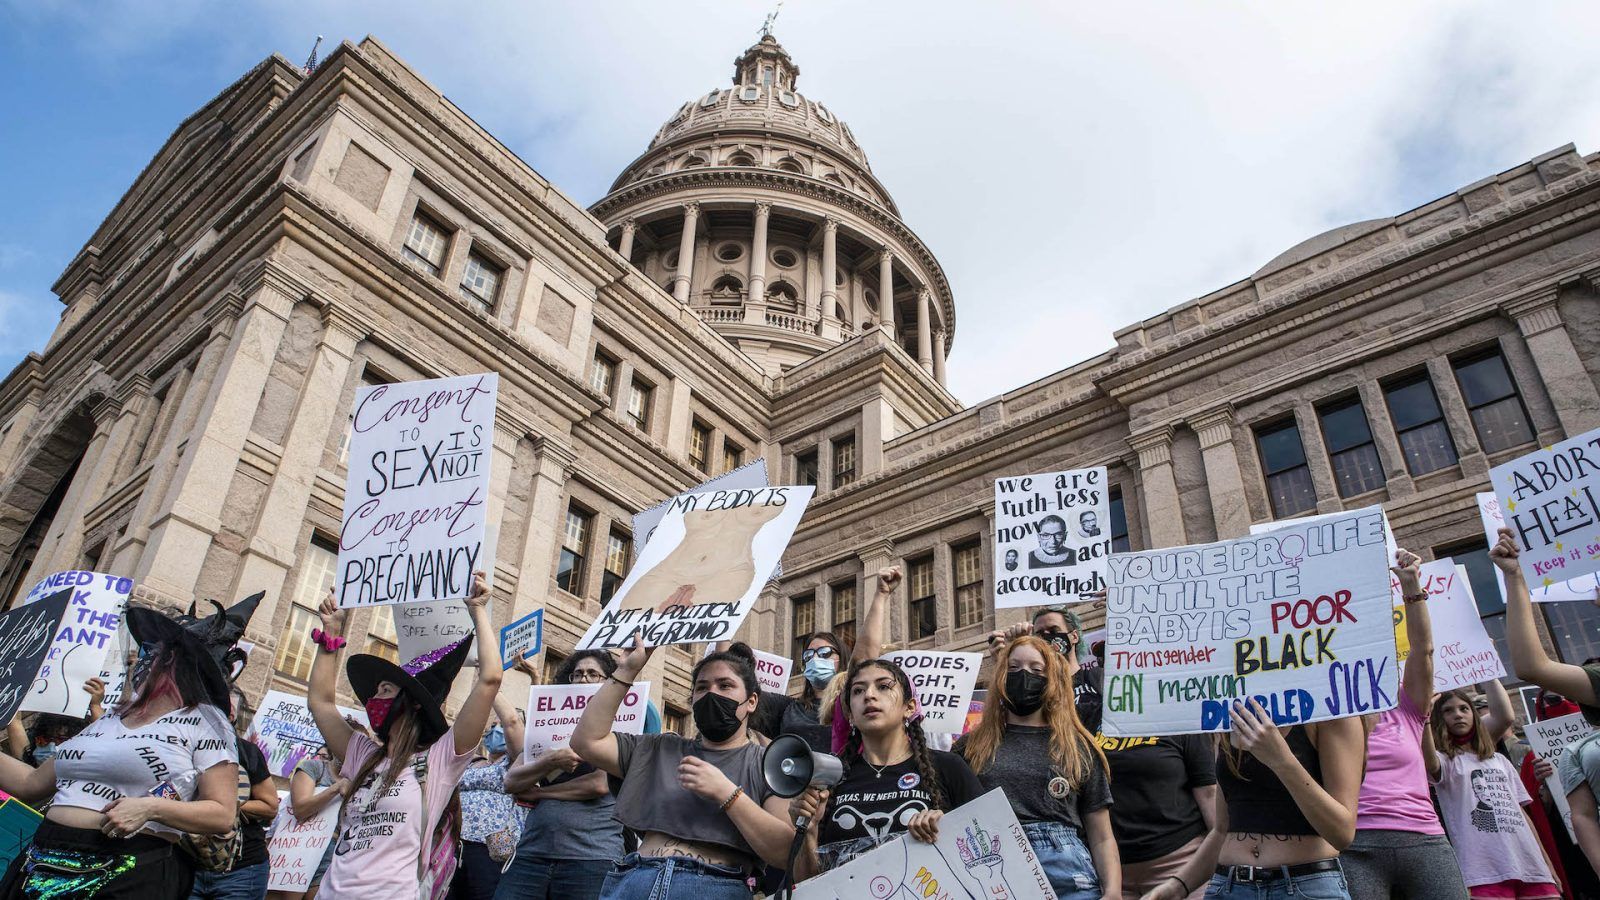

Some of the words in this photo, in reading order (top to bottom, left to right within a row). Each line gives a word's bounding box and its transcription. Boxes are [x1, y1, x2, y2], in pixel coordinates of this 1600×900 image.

[353, 376, 490, 433] Consent
[400, 427, 420, 442] TO
[448, 424, 483, 450] IS
[366, 441, 443, 497] SEX
[440, 453, 483, 479] NOT
[998, 477, 1033, 493] we
[1055, 470, 1099, 490] are
[667, 494, 706, 514] MY
[707, 489, 765, 512] BODY
[761, 488, 789, 507] IS
[1001, 488, 1100, 517] ruth-less
[340, 487, 483, 551] Consent
[997, 521, 1041, 543] now
[386, 539, 409, 554] TO
[1078, 540, 1110, 561] act
[1533, 556, 1566, 576] Keep
[1569, 548, 1582, 560] it
[45, 571, 94, 589] NEED
[105, 575, 134, 595] TO
[340, 542, 481, 606] PREGNANCY
[997, 571, 1106, 600] accordingly
[1108, 579, 1214, 614] UNTIL
[1219, 565, 1300, 607] THE
[78, 608, 120, 631] THE
[403, 607, 433, 618] KEEP
[600, 607, 641, 625] NOT
[638, 608, 654, 623] A
[659, 601, 741, 620] POLITICAL
[1106, 611, 1207, 645] BABY
[1211, 609, 1251, 640] IS
[1270, 589, 1358, 633] POOR
[402, 624, 429, 637] SAFE
[513, 620, 536, 637] DEMAND
[586, 620, 731, 649] PLAYGROUND
[506, 633, 533, 650] ABORTION
[1111, 646, 1217, 669] Transgender
[1235, 627, 1337, 677] BLACK
[1440, 642, 1466, 659] are
[757, 660, 783, 676] RTO
[1445, 650, 1495, 671] human
[910, 674, 956, 690] GHT,
[537, 696, 556, 711] EL
[1107, 673, 1144, 715] GAY
[1201, 688, 1315, 731] DIBLED
[1325, 656, 1393, 716] SICK
[535, 719, 546, 727] ES
[613, 713, 636, 722] ALUD
[1537, 727, 1562, 738] How
[1565, 722, 1579, 732] to
[1547, 738, 1564, 747] an
[863, 792, 874, 801] WE
[876, 791, 897, 801] NEED
[899, 790, 910, 798] TO
[911, 789, 931, 801] TALK
[361, 812, 407, 827] RESISTANCE
[305, 836, 328, 849] OUT
[357, 825, 394, 840] BECOMES
[280, 871, 308, 886] DOG
